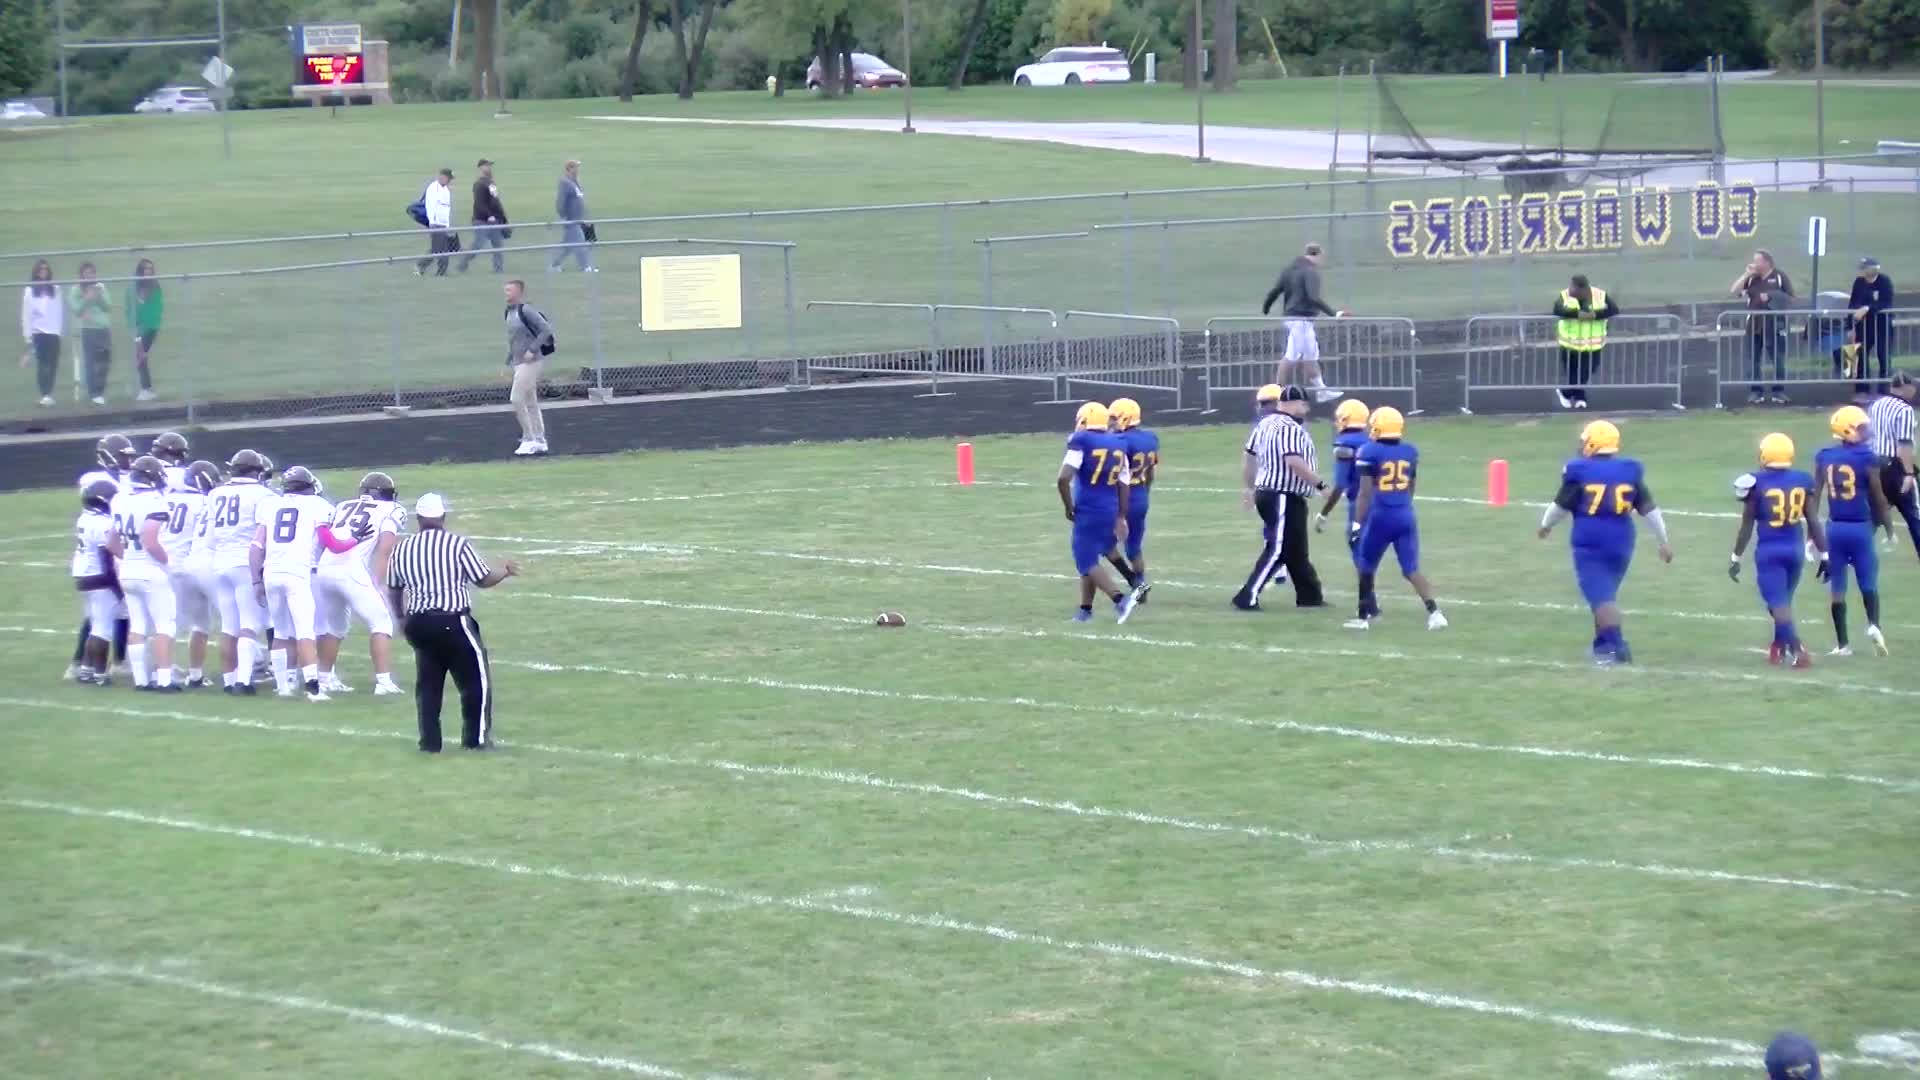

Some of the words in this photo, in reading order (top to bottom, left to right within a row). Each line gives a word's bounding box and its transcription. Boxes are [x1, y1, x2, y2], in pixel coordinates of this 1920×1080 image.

[1090, 448, 1124, 486] 72
[1378, 459, 1411, 492] 25
[1826, 463, 1856, 500] 13
[215, 494, 240, 528] 28
[335, 501, 377, 532] 75
[1584, 483, 1634, 515] 76
[1765, 487, 1806, 528] 38
[273, 507, 299, 543] 8
